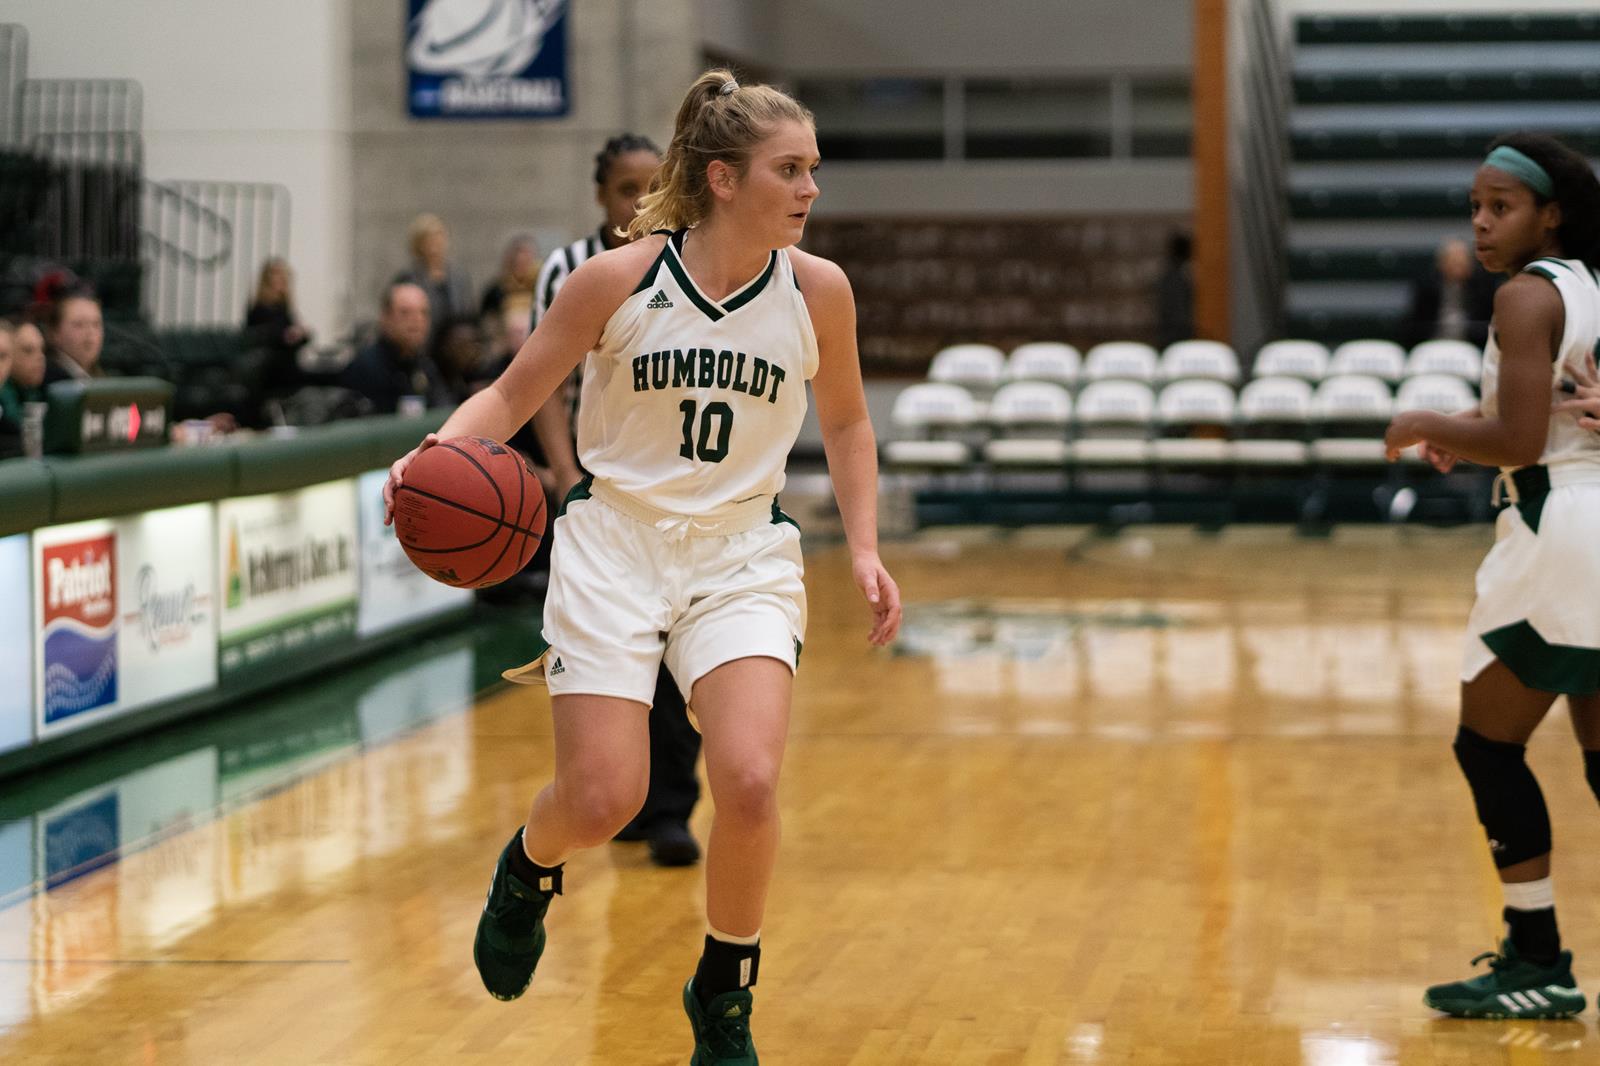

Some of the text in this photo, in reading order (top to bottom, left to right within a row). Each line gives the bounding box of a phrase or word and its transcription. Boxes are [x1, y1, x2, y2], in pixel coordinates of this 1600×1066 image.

[647, 301, 674, 309] adidas
[632, 348, 786, 404] HUMBOLDT
[679, 399, 734, 463] 10
[48, 548, 112, 608] Patriot
